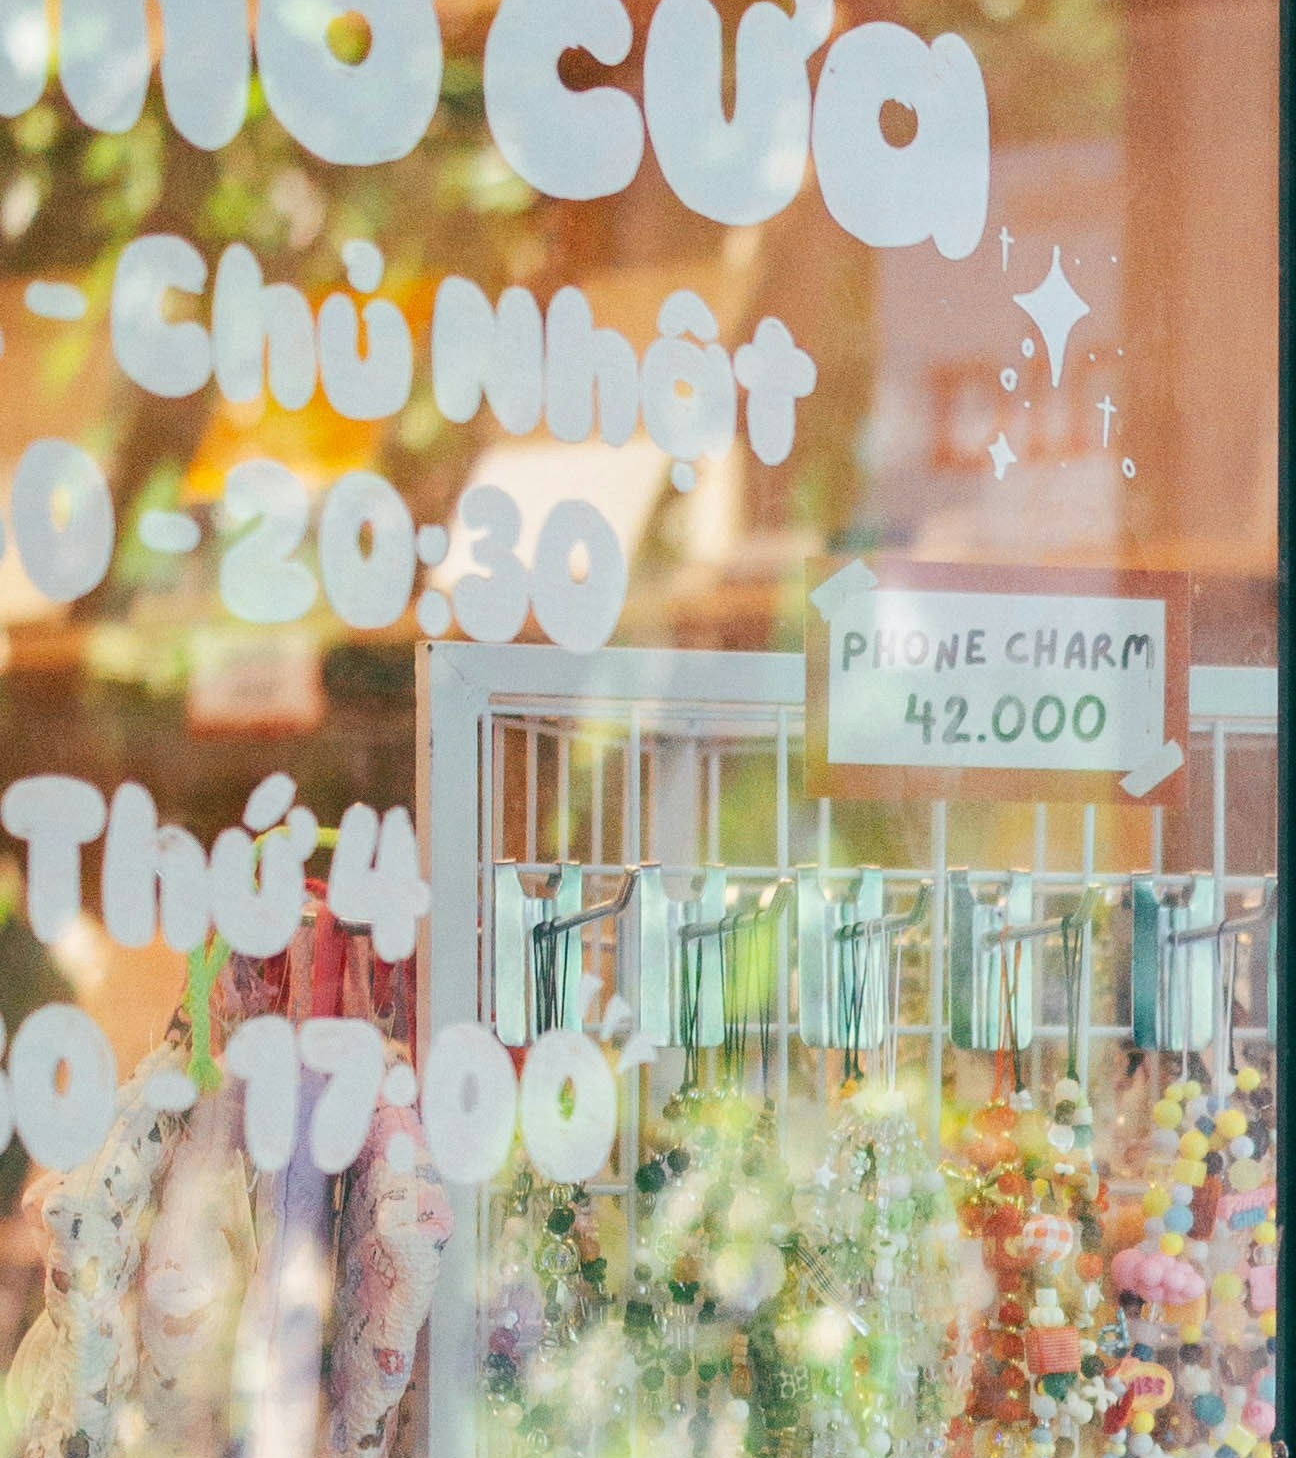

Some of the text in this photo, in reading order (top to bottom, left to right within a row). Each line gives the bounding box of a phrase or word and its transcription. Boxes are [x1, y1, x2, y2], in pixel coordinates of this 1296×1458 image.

[110, 232, 414, 420] Chủ
[430, 274, 818, 493] Nhật
[219, 457, 628, 653] 20:30
[841, 629, 1156, 672] PHONE CHARM
[904, 693, 1107, 744] 42.000
[0, 772, 432, 963] Thứ 4
[224, 1013, 620, 1184] 17:00
